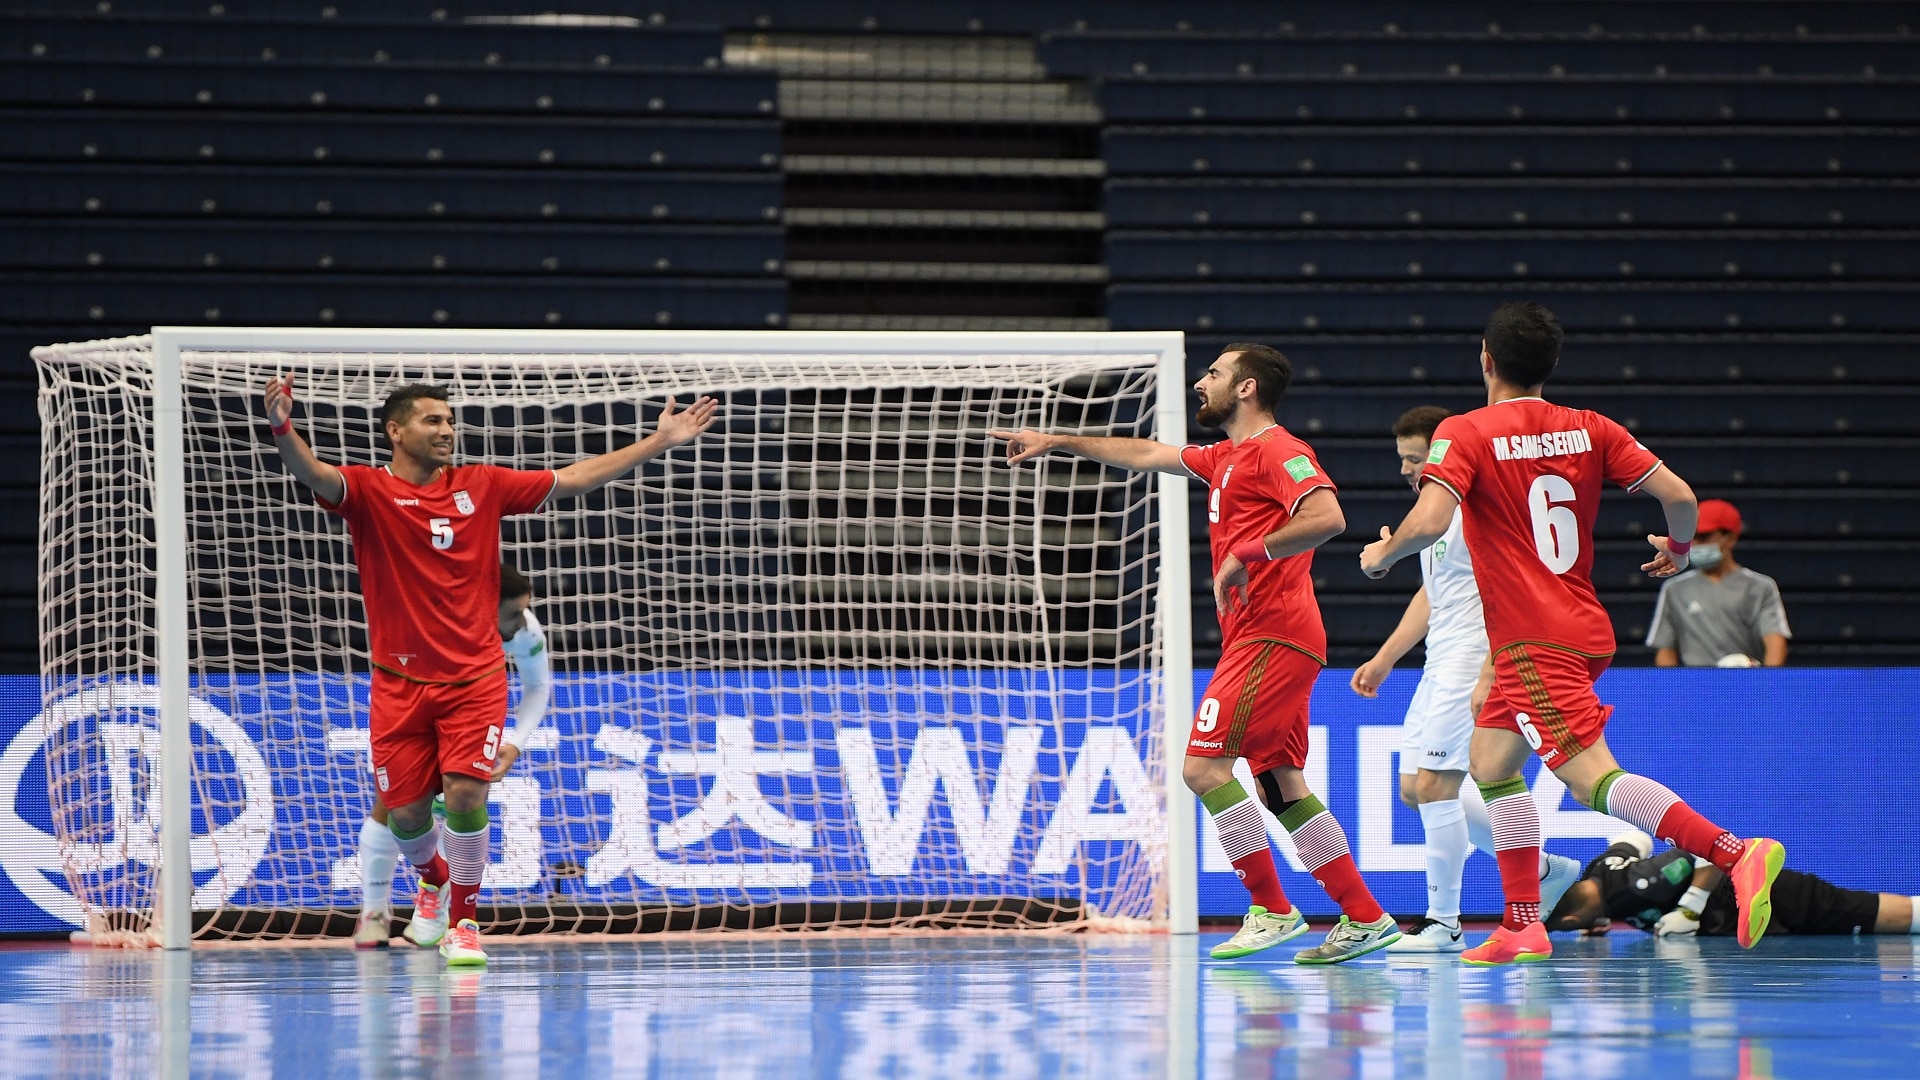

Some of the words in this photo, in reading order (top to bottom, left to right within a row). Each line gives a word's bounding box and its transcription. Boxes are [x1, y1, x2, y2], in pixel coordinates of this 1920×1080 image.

[1208, 487, 1221, 524] 9
[429, 517, 454, 550] 5
[1527, 474, 1580, 575] 6
[1196, 697, 1220, 733] 9
[1515, 712, 1543, 751] 6
[482, 724, 500, 761] 5
[1427, 750, 1447, 758] JAKO
[834, 725, 1648, 875] WAND
